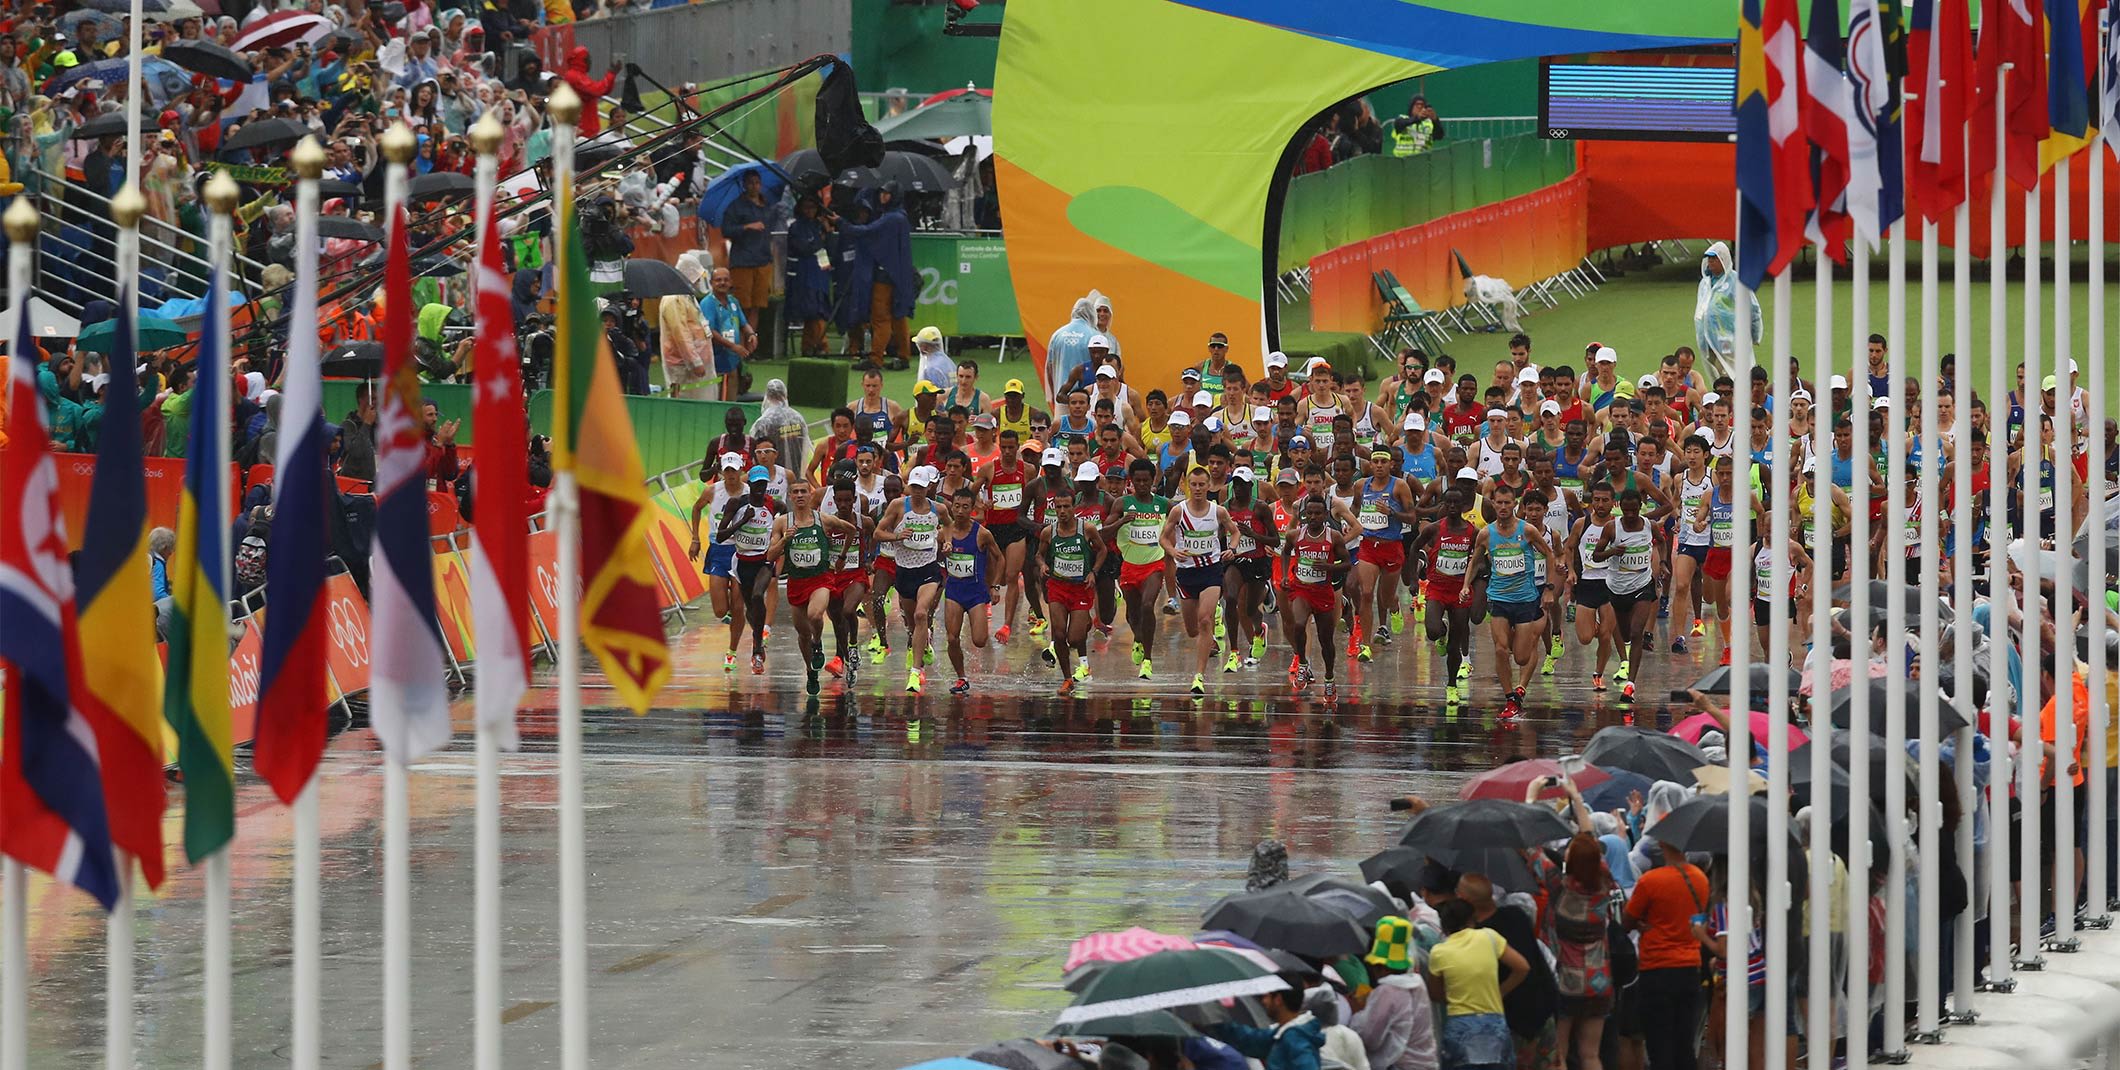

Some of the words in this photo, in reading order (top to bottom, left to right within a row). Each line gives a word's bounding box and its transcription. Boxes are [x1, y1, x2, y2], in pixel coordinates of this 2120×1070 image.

[1454, 425, 1472, 434] CUBA
[1314, 435, 1334, 444] PFLIEG
[993, 493, 1022, 503] SAAD
[1360, 515, 1388, 525] GIRALDO
[908, 533, 930, 542] RUPP
[1130, 530, 1157, 540] LILESA
[791, 536, 820, 545] ALGERIA
[1184, 539, 1213, 549] MOEN
[1055, 545, 1081, 553] ALGERIA
[1440, 542, 1470, 551] DANMARK
[793, 552, 815, 563] SADI
[1299, 551, 1330, 560] BAHRAIN
[1619, 555, 1649, 565] KINDE
[1437, 559, 1467, 569] ULAD
[1495, 558, 1524, 569] PRODIUS
[1297, 566, 1327, 578] BEKELE
